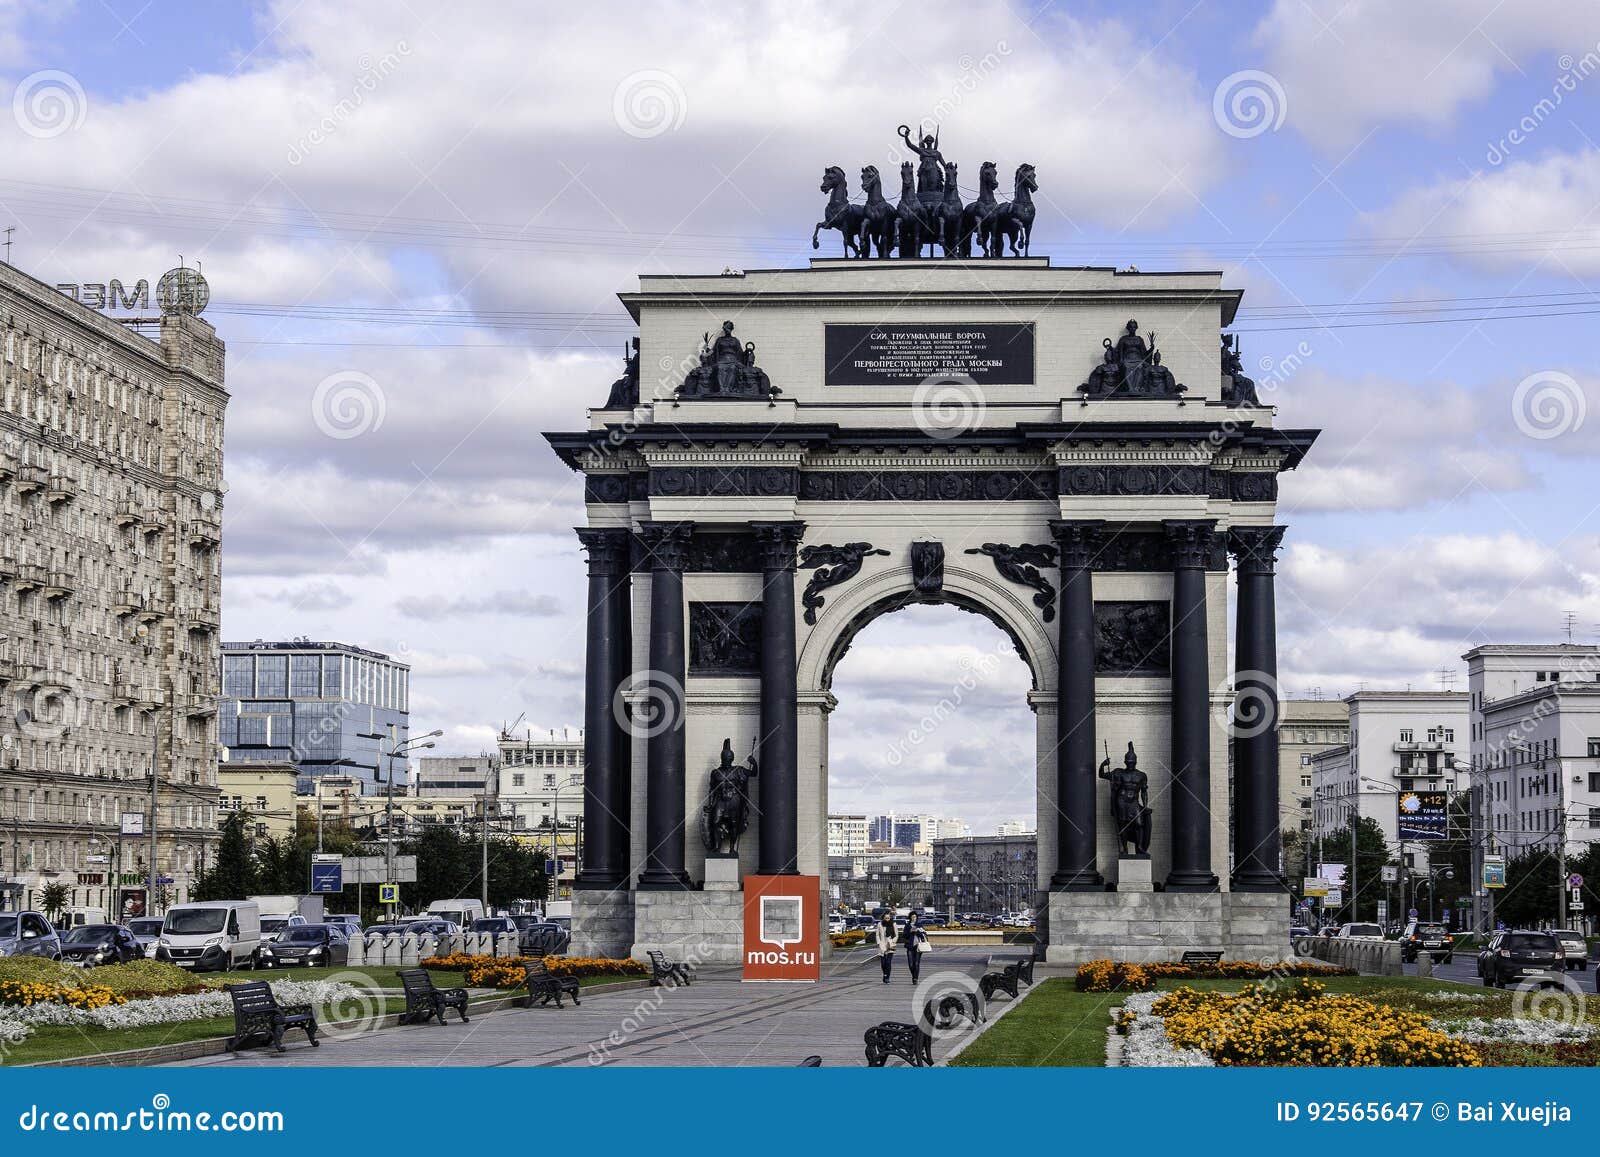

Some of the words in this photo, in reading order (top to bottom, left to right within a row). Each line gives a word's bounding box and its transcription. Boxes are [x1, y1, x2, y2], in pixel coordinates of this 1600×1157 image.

[891, 332, 953, 340] ТРИУМФАЛЬНЫЕ
[956, 332, 986, 340] ВОРОТА
[854, 360, 939, 368] ПЕРВОПРЕСТОЛЬНОГО
[942, 360, 966, 368] ГРАДА
[969, 360, 1003, 368] МОСКВЫ
[747, 951, 815, 965] mos.ru
